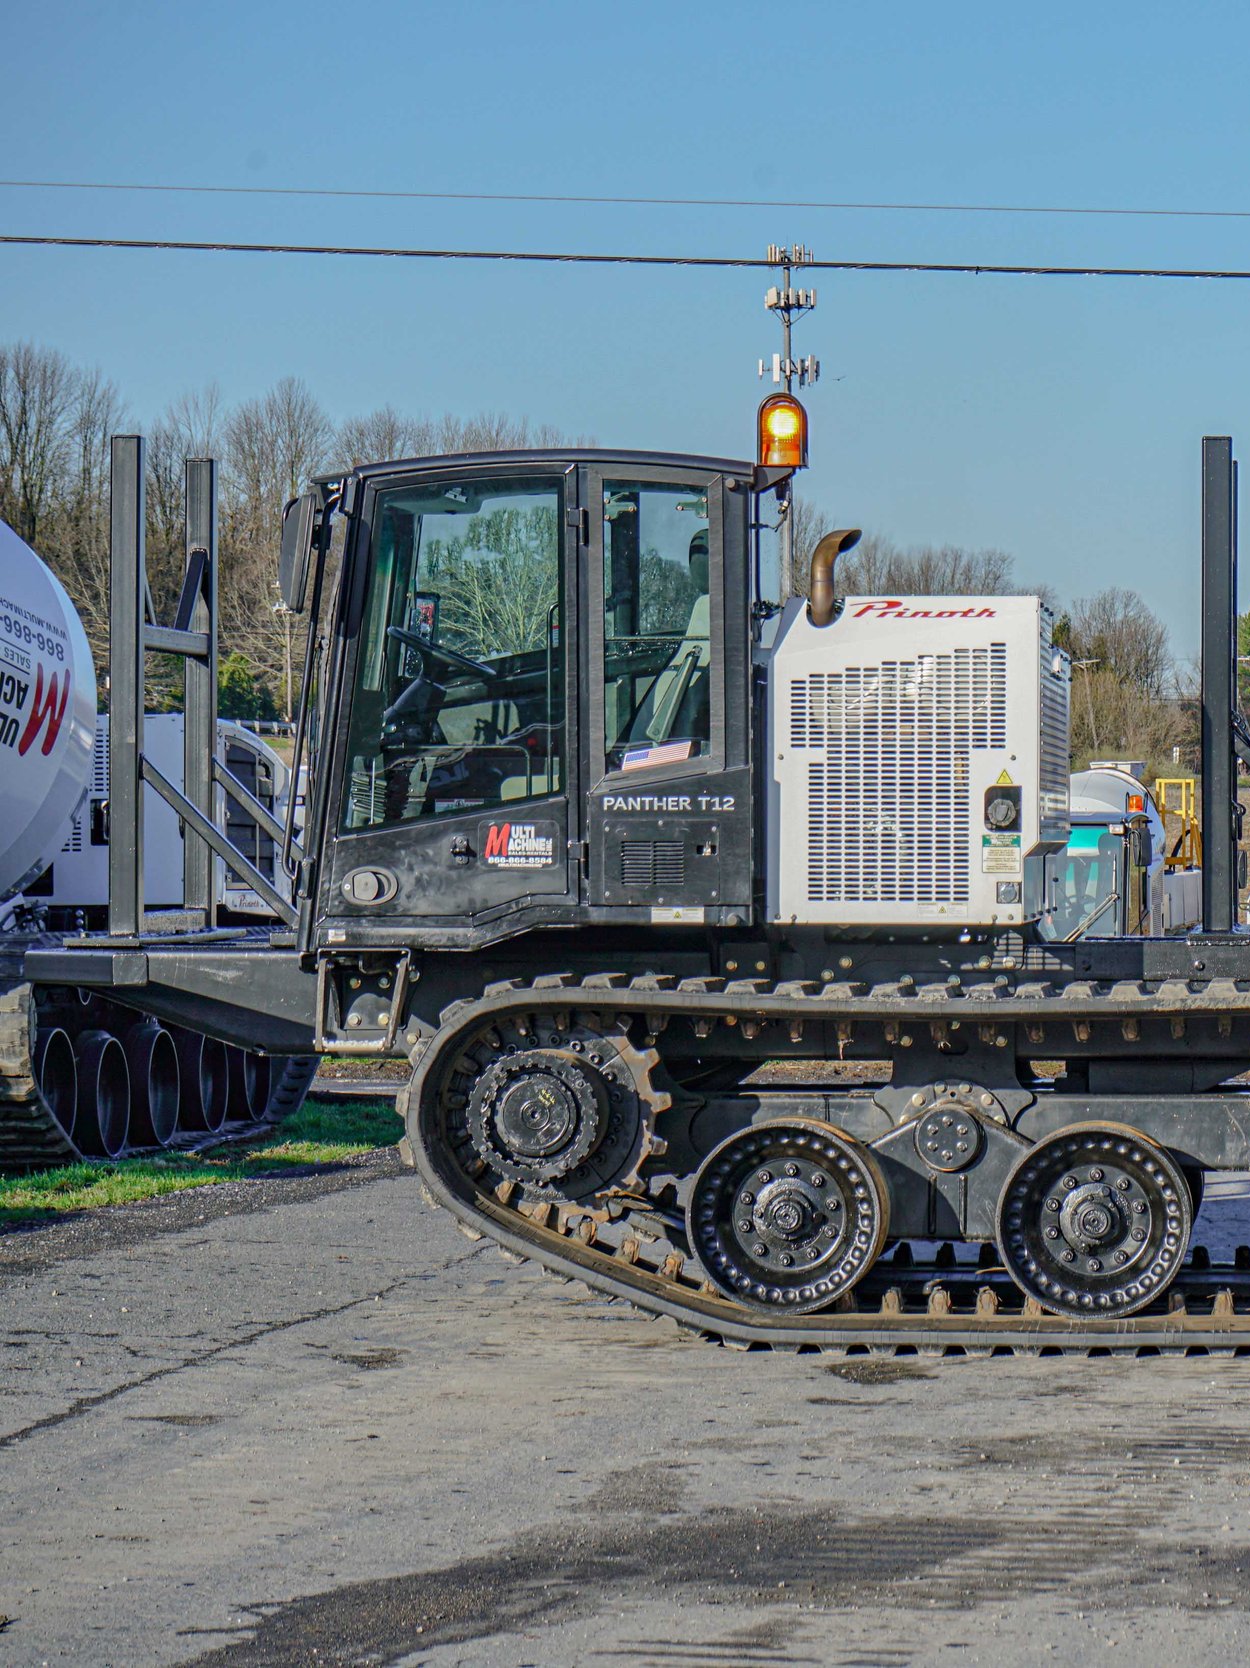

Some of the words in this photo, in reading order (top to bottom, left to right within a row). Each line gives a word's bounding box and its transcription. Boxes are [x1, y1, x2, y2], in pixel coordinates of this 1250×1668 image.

[850, 600, 997, 618] Prinoth
[4, 647, 31, 670] SALES
[603, 797, 692, 811] PANTHER
[698, 797, 735, 811] T12
